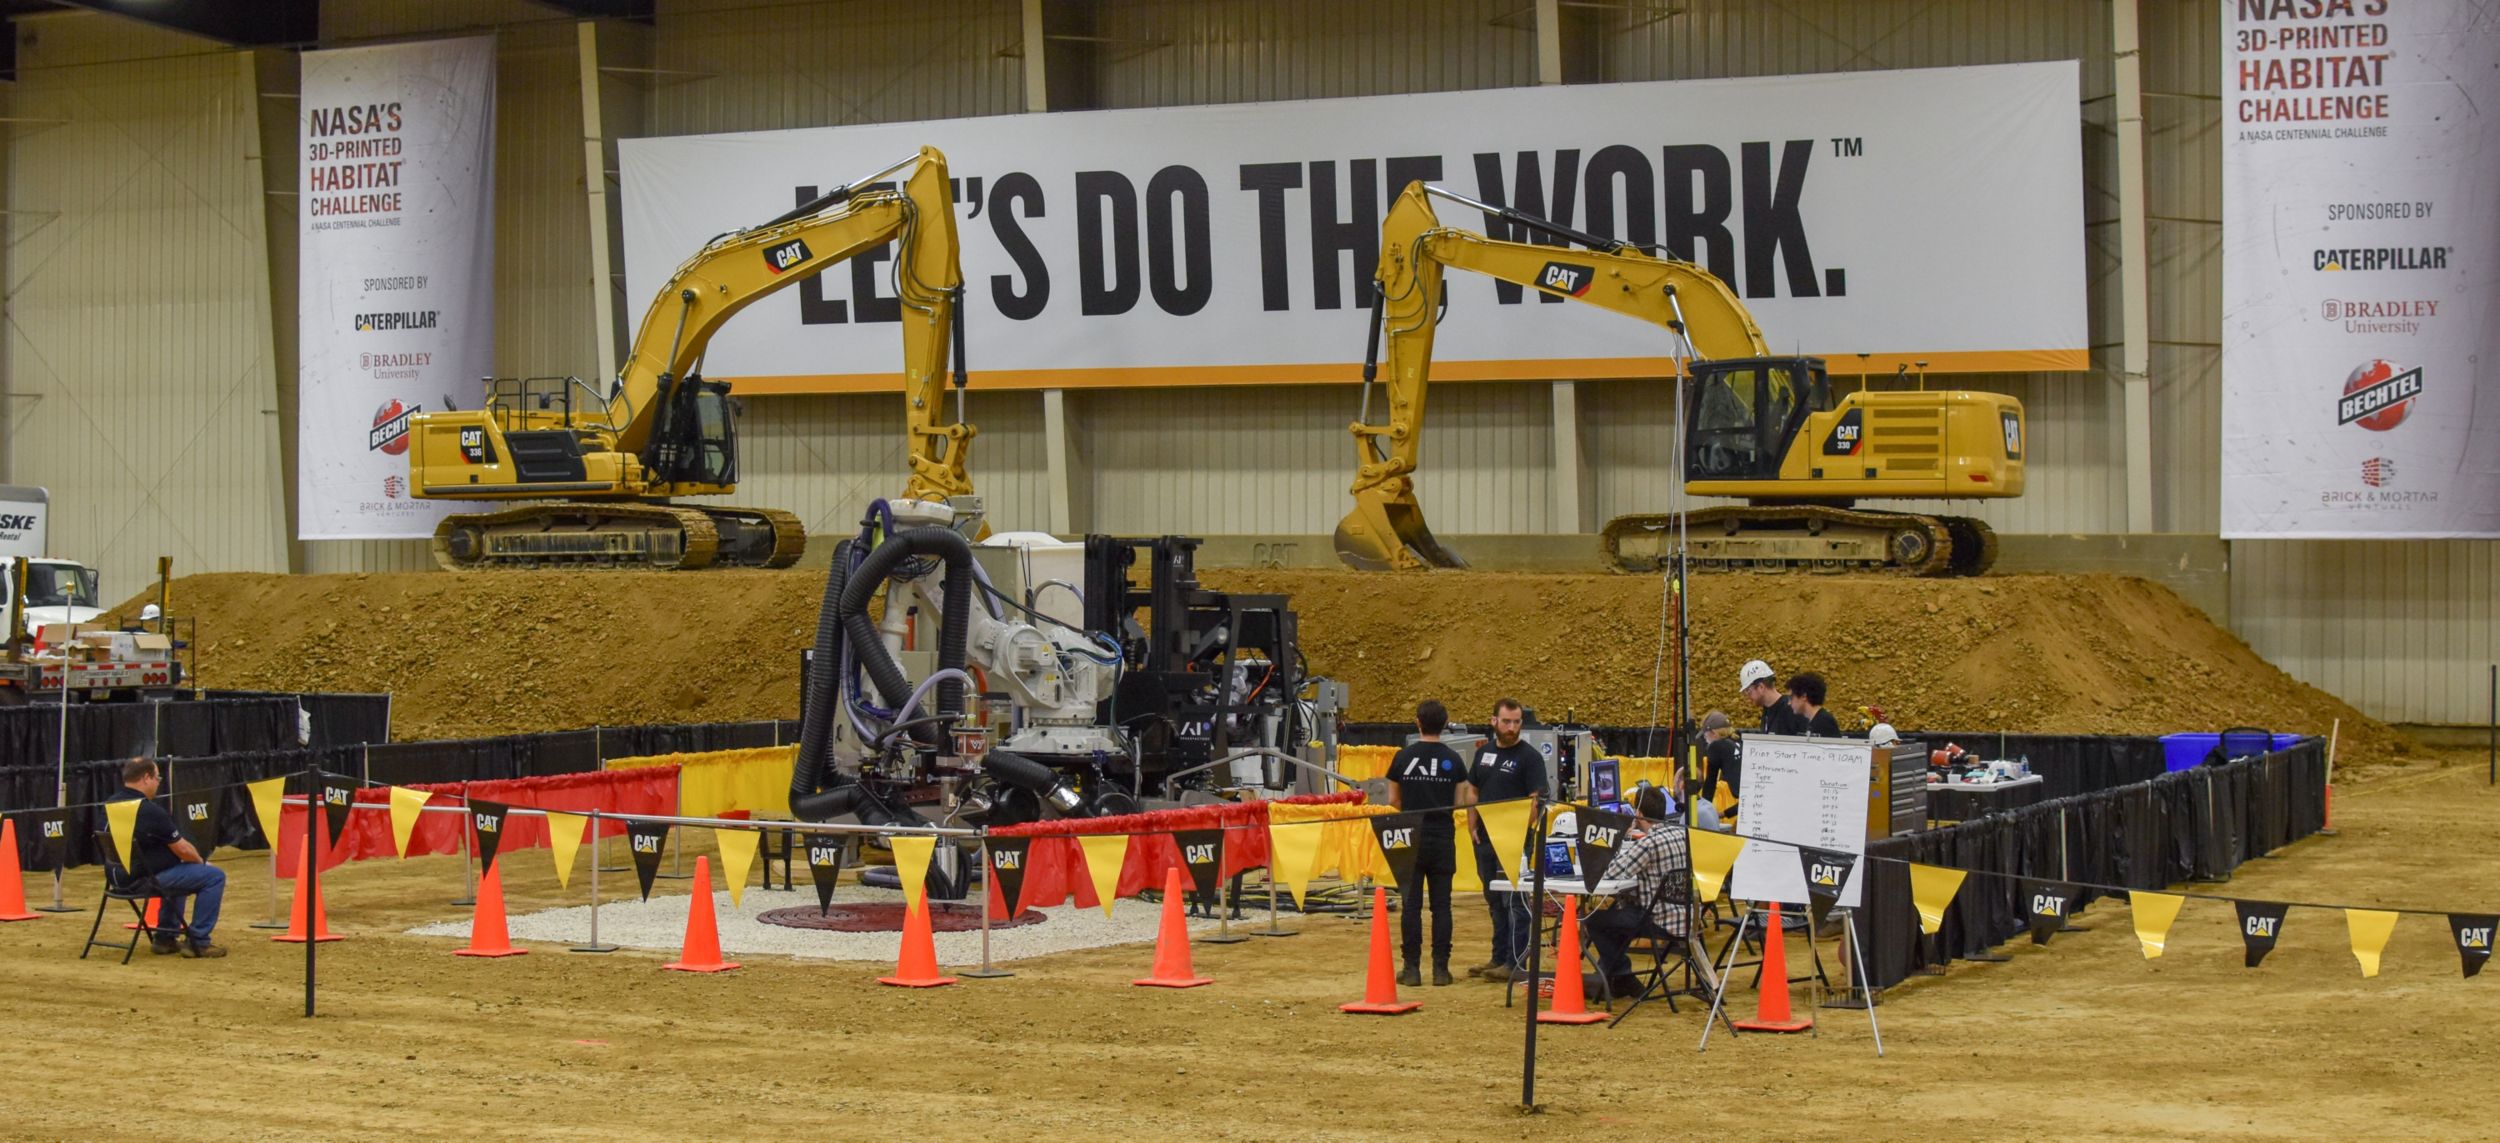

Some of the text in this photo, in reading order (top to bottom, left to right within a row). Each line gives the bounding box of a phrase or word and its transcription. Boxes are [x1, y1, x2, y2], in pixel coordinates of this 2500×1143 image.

[2237, 24, 2388, 52] 3D-PRINTED
[2239, 54, 2389, 91] HABITAT
[2239, 95, 2389, 123] CHALLENGE
[310, 102, 402, 137] NASA'S
[2239, 126, 2388, 142] A NASA CENTENNIAL CHALLENGE
[309, 138, 402, 161] 3D-PRINTED
[311, 162, 402, 192] HABITAT
[311, 193, 402, 216] CHALLENGE
[2329, 202, 2433, 221] SPONSORED BY
[316, 221, 331, 230] NASA
[332, 219, 367, 230] CENTENNIAL
[368, 217, 401, 228] CHALLENGE
[1075, 164, 1213, 317] DO
[1473, 139, 1847, 305] WORK.
[776, 241, 803, 269] CAT
[364, 275, 429, 291] SPONSORED BY
[1545, 265, 1579, 291] CAT
[2345, 301, 2439, 317] BRADLEY
[2345, 320, 2420, 336] University
[374, 353, 432, 367] BRADLEY
[374, 369, 420, 381] University
[2341, 373, 2421, 421] BECHTEL
[371, 414, 410, 448] BECHT
[461, 431, 482, 447] CAT
[1837, 425, 1859, 440] CAT
[2005, 419, 2021, 454] CAT
[470, 447, 482, 457] 336
[1837, 441, 1850, 449] 330
[2321, 491, 2363, 503] BRICK
[2379, 491, 2439, 503] MORTAR
[1750, 747, 1770, 758] Print
[1775, 750, 1797, 760] Start
[1802, 751, 1826, 761] Time:
[326, 786, 350, 806] CAT
[188, 803, 208, 821] CAT
[44, 820, 64, 838] CAT
[476, 813, 498, 832] CAT
[634, 834, 659, 853] CAT
[1382, 828, 1412, 850] CAT
[1584, 824, 1618, 848] CAT
[811, 847, 836, 866] CAT
[995, 850, 1020, 869] CAT
[1186, 844, 1214, 864] CAT
[1811, 863, 1843, 886] CAT
[2033, 894, 2064, 916] CAT
[2246, 916, 2276, 937] CAT
[2461, 927, 2490, 947] CAT
